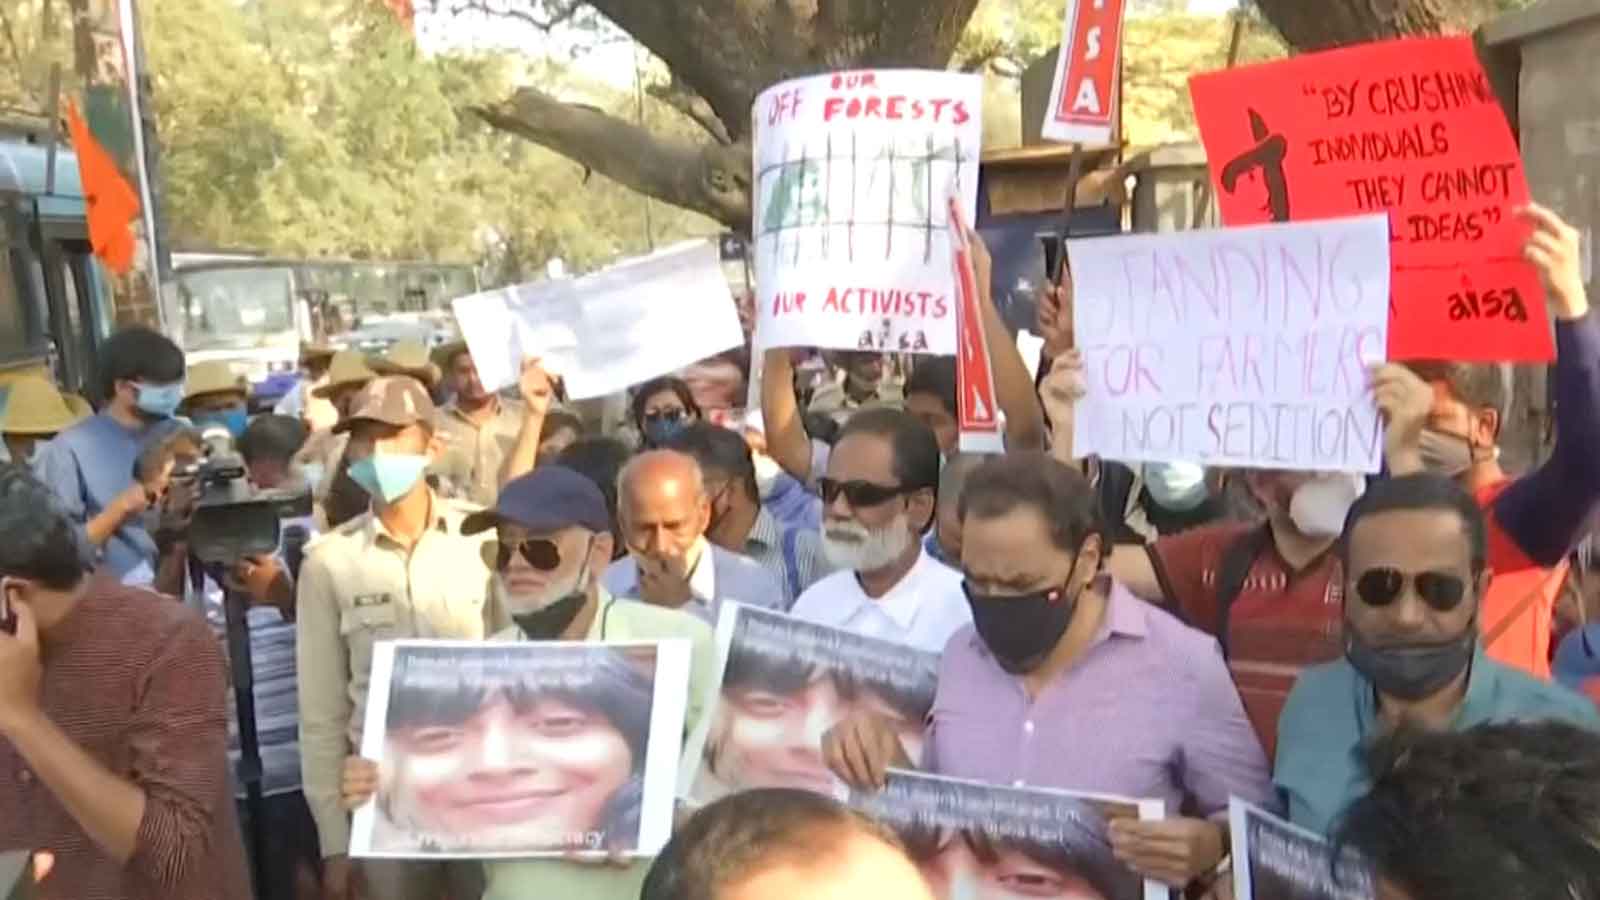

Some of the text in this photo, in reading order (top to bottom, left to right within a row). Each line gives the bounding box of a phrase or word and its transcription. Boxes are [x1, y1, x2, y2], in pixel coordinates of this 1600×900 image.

[823, 95, 970, 125] FORESTS
[1346, 163, 1517, 211] THEY CANNOT
[822, 287, 948, 319] ACTIVISTS
[1448, 274, 1528, 323] aisa
[1086, 341, 1165, 398] FOR
[1121, 399, 1385, 466] NOT SEDITION
